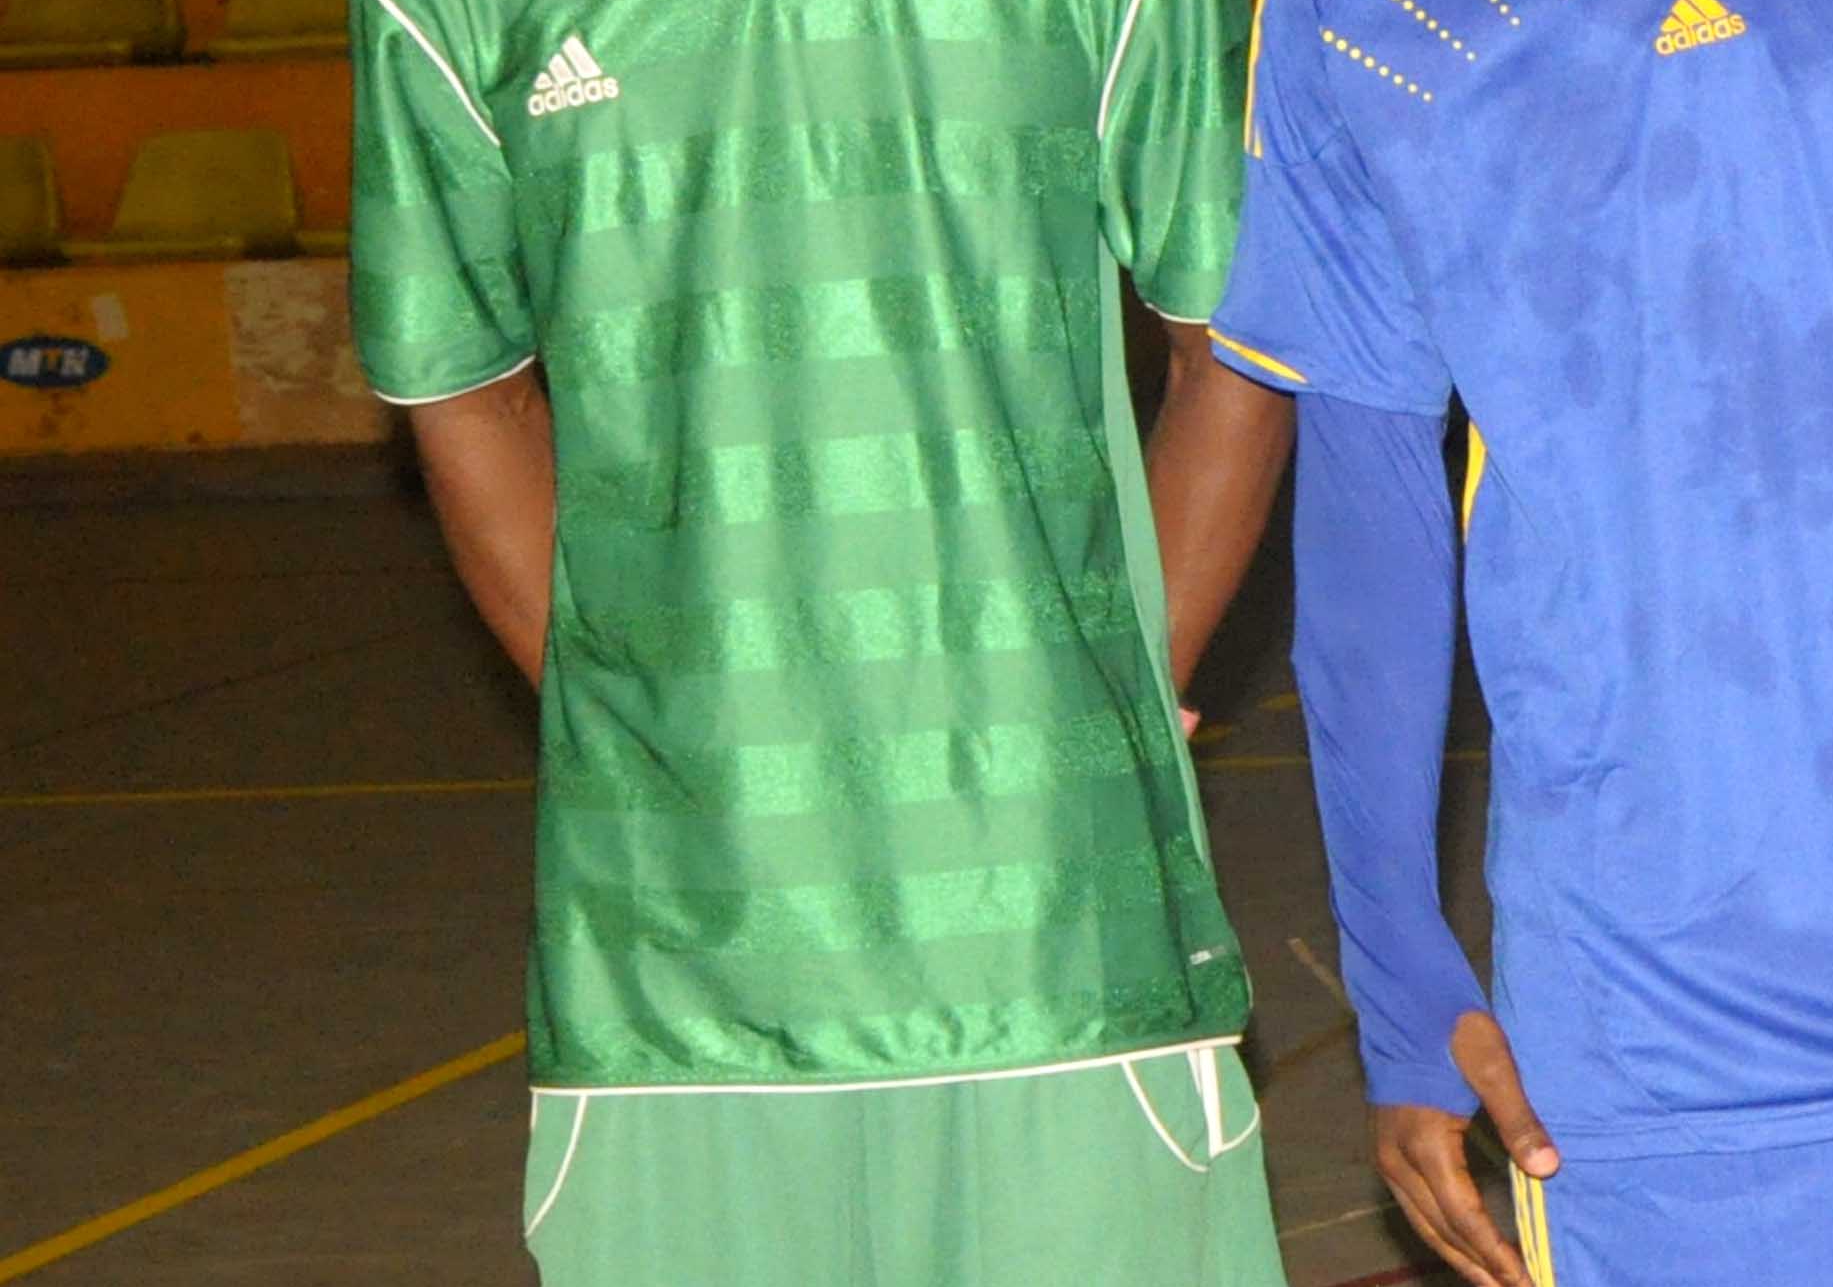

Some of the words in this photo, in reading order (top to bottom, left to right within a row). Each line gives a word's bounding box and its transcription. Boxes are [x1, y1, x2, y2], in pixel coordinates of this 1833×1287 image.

[1655, 13, 1748, 55] adidas
[527, 76, 620, 117] adidas
[7, 347, 90, 377] MTN
